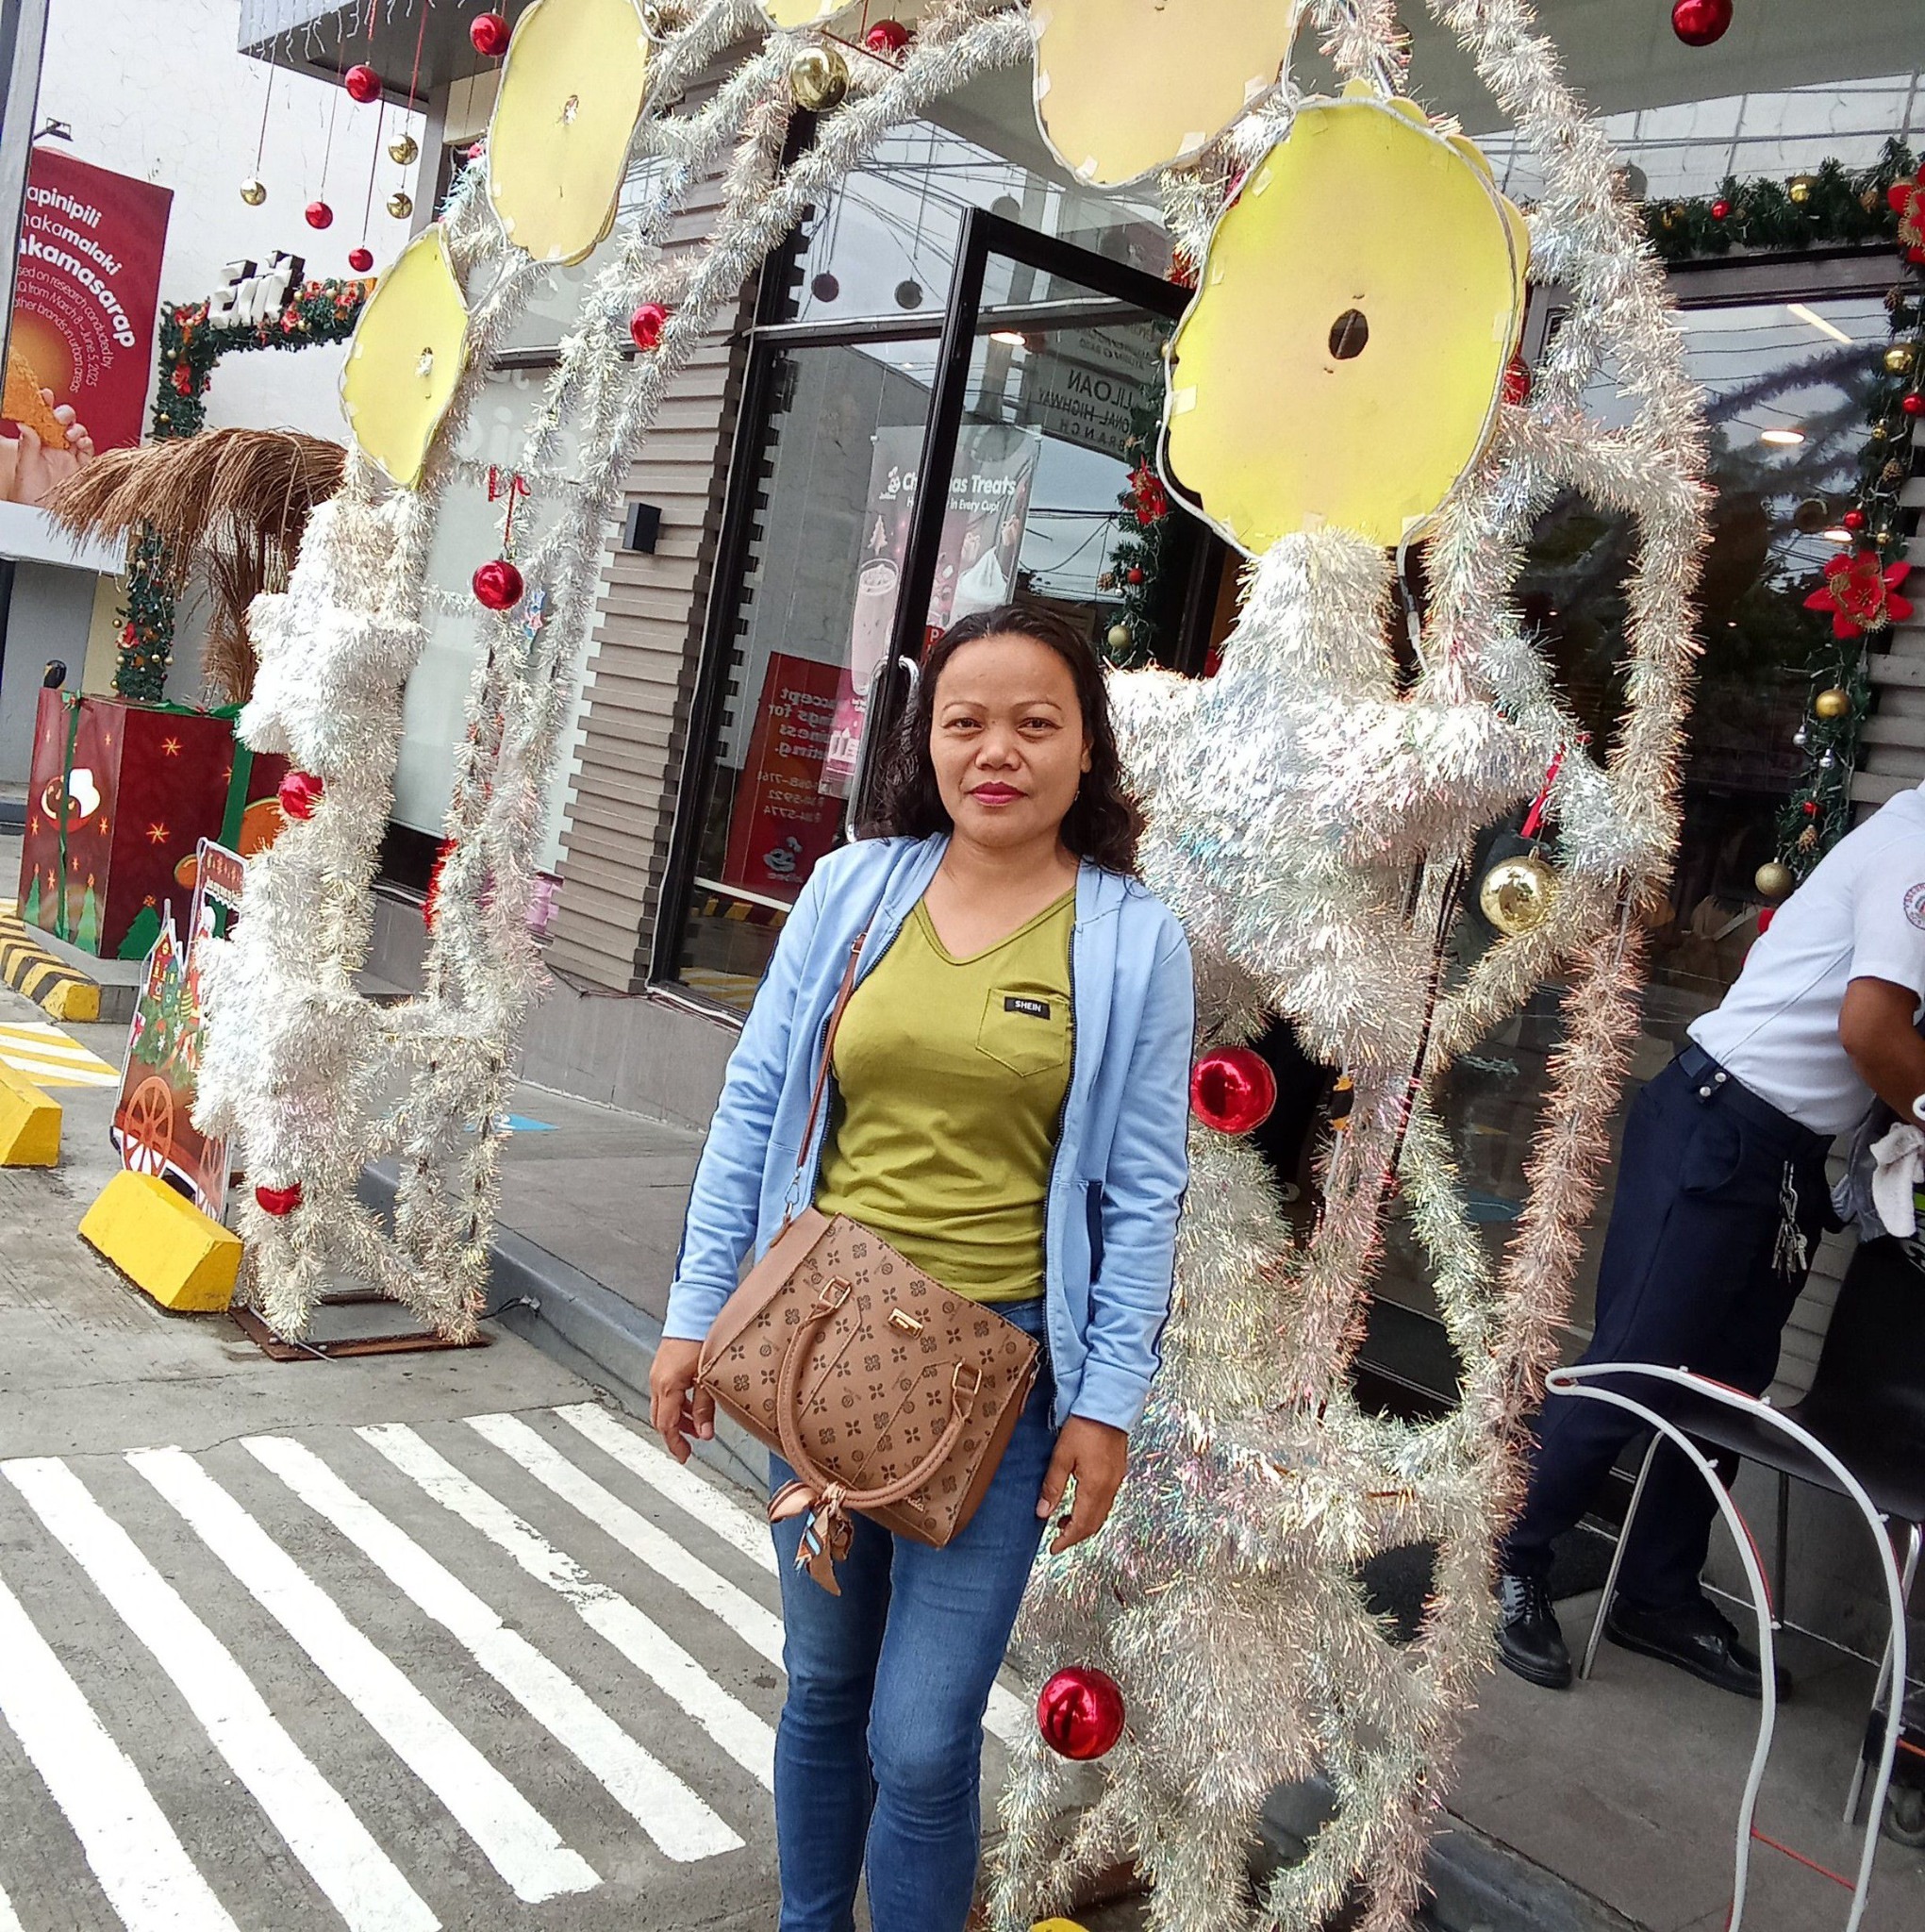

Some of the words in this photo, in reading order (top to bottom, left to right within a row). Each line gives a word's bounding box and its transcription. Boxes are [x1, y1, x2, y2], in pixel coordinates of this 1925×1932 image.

[26, 186, 102, 228] apinipili
[24, 213, 123, 275] nakamalaki
[17, 266, 36, 278] sed
[36, 270, 50, 283] on
[49, 276, 88, 309] research
[19, 233, 136, 347] kamasarap
[207, 249, 305, 330] Exit
[37, 302, 69, 332] brands
[48, 292, 77, 320] March
[85, 363, 99, 388] 2025
[959, 498, 981, 512] Every
[971, 474, 1018, 496] Treats
[1014, 1000, 1042, 1013] SHEIN
